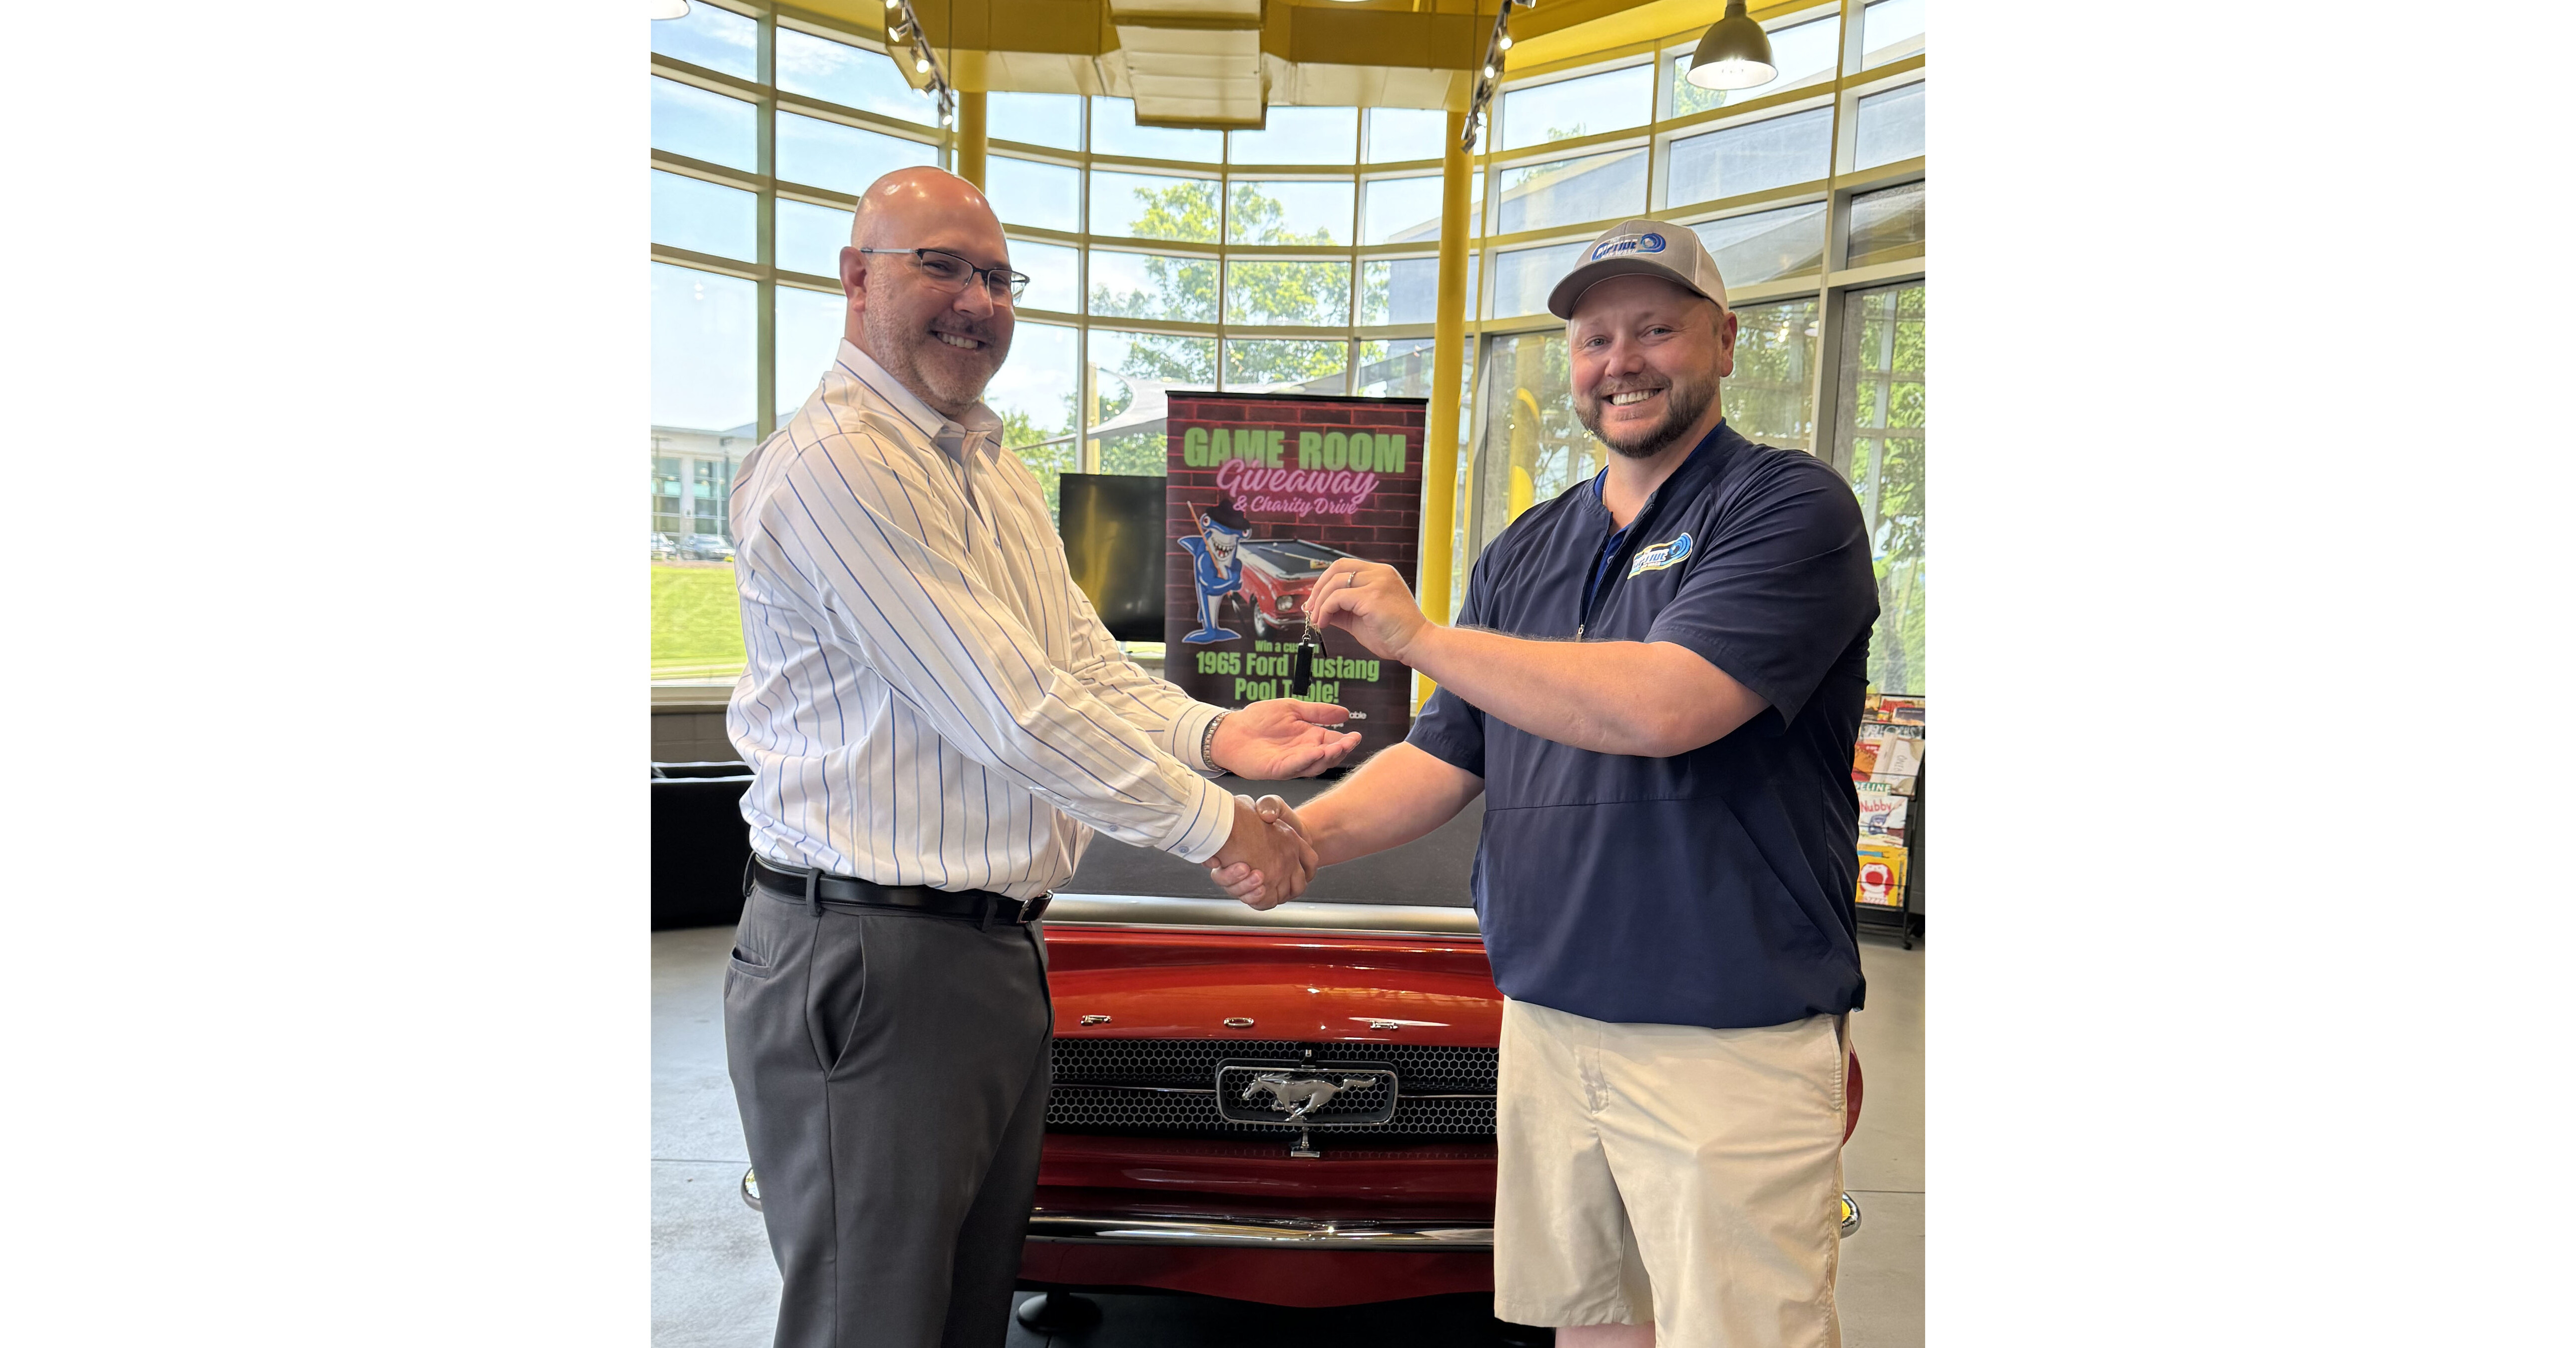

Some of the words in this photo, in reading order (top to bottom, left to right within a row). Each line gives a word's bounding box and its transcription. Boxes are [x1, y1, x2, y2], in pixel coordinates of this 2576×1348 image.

[1184, 427, 1285, 468] GAME
[1299, 431, 1406, 473] ROOM
[1216, 458, 1380, 504] Giveaway
[1233, 495, 1248, 511] &
[1250, 495, 1312, 517] Charity
[1313, 497, 1358, 515] Drive
[1255, 640, 1273, 652] Win
[1275, 642, 1281, 652] a
[1196, 651, 1240, 675] 1965
[1246, 653, 1289, 677] Ford
[1294, 655, 1380, 681] ustang
[1235, 678, 1277, 701] Pool
[1282, 680, 1339, 704] Tble!
